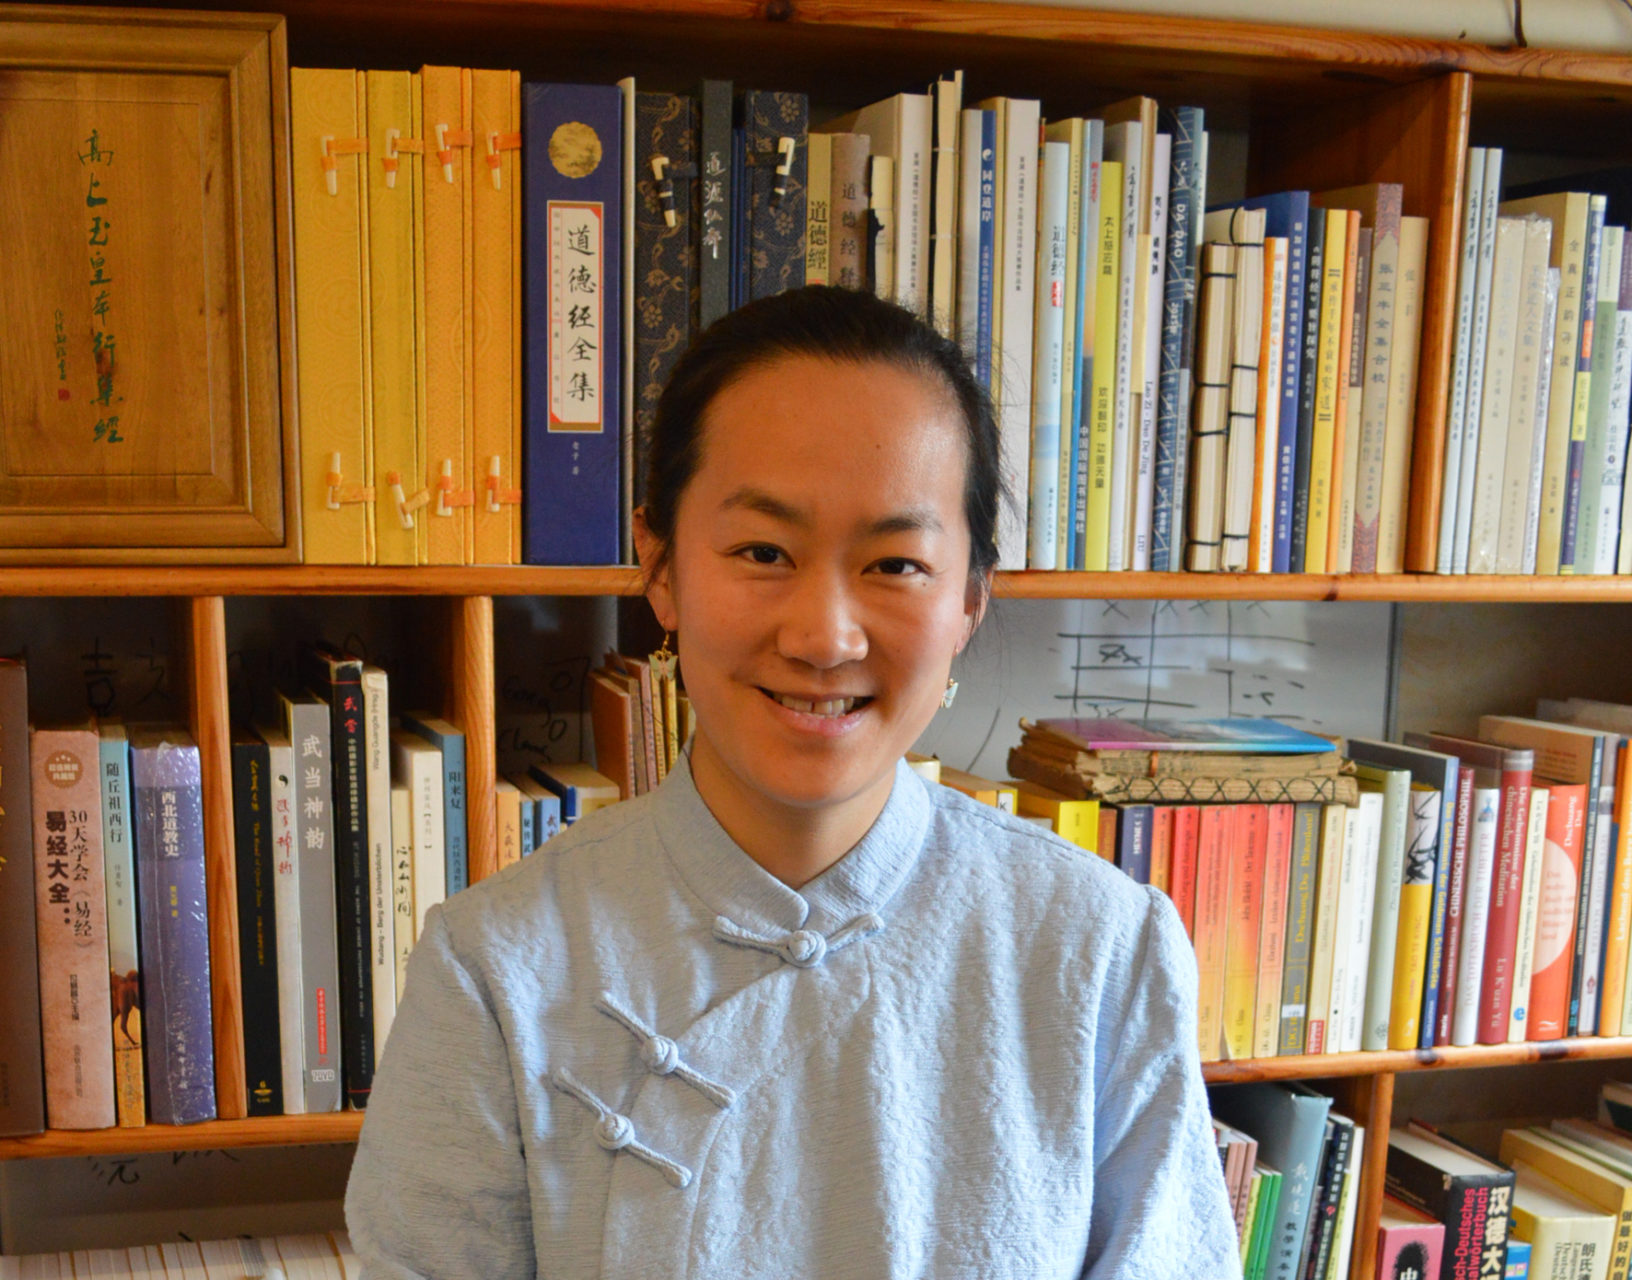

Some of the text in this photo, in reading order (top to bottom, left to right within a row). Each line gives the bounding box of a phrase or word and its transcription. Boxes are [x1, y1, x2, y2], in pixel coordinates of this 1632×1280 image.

[808, 201, 828, 270] 道德經
[1173, 230, 1185, 259] DAO
[567, 224, 597, 402] 道德经全集
[105, 762, 122, 843] 随丘祖西行
[161, 790, 180, 857] 西北道教史
[302, 735, 325, 850] 武当神韵
[1456, 778, 1471, 847] PHILOSOPHIE
[1564, 796, 1577, 847] Dschuang
[375, 843, 383, 895] Unsterblichen
[1442, 819, 1453, 869] Geheimnis
[1495, 785, 1515, 908] chinesischen Meditation
[1511, 805, 1526, 871] Geheimnisse
[1436, 891, 1446, 934] Goldenen
[1449, 848, 1464, 918] CHINESISCHE
[1616, 892, 1626, 941] Lachend
[377, 936, 385, 965] Wudang
[1430, 935, 1442, 990] Schildkröte
